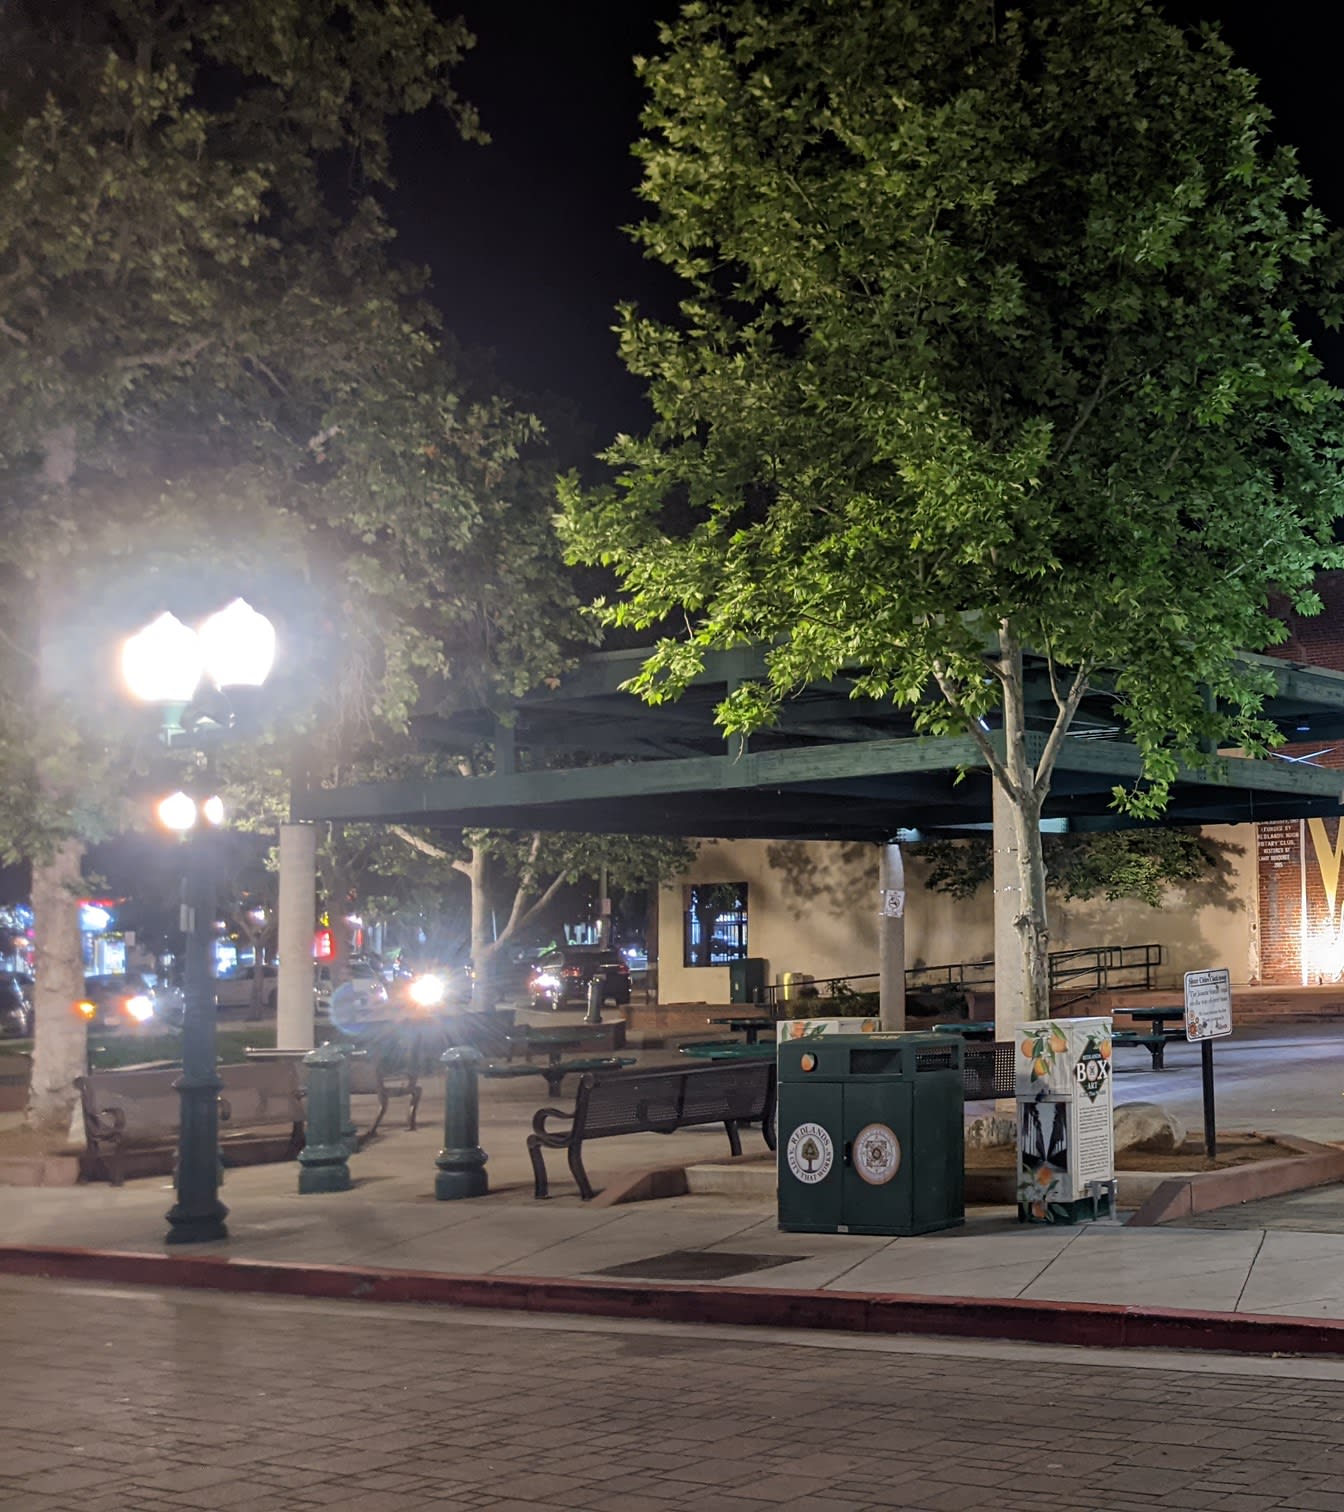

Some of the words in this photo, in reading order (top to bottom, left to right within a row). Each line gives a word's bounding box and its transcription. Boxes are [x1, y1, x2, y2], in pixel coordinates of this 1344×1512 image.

[1076, 1060, 1109, 1082] BOX
[792, 1126, 830, 1146] REDLANDS
[800, 1171, 817, 1181] THAT
